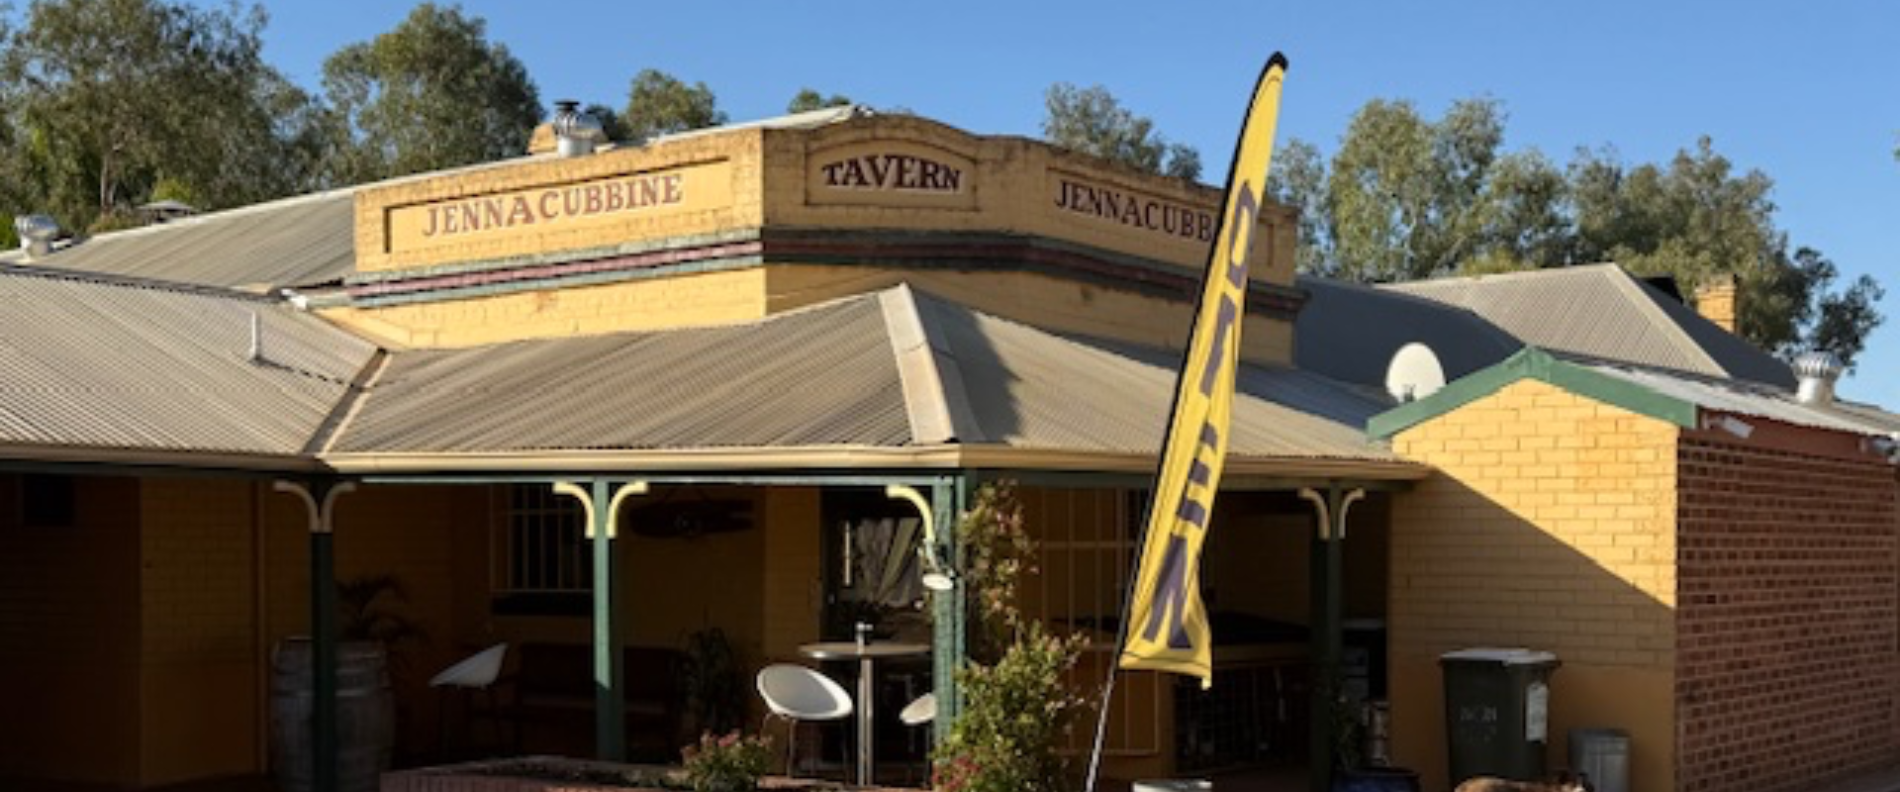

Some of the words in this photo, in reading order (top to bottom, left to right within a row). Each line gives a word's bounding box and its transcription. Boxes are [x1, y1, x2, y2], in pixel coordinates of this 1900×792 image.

[821, 153, 962, 192] TAVERN
[422, 173, 682, 237] JENNACUBBINE
[1054, 179, 1213, 243] JENNACUBB
